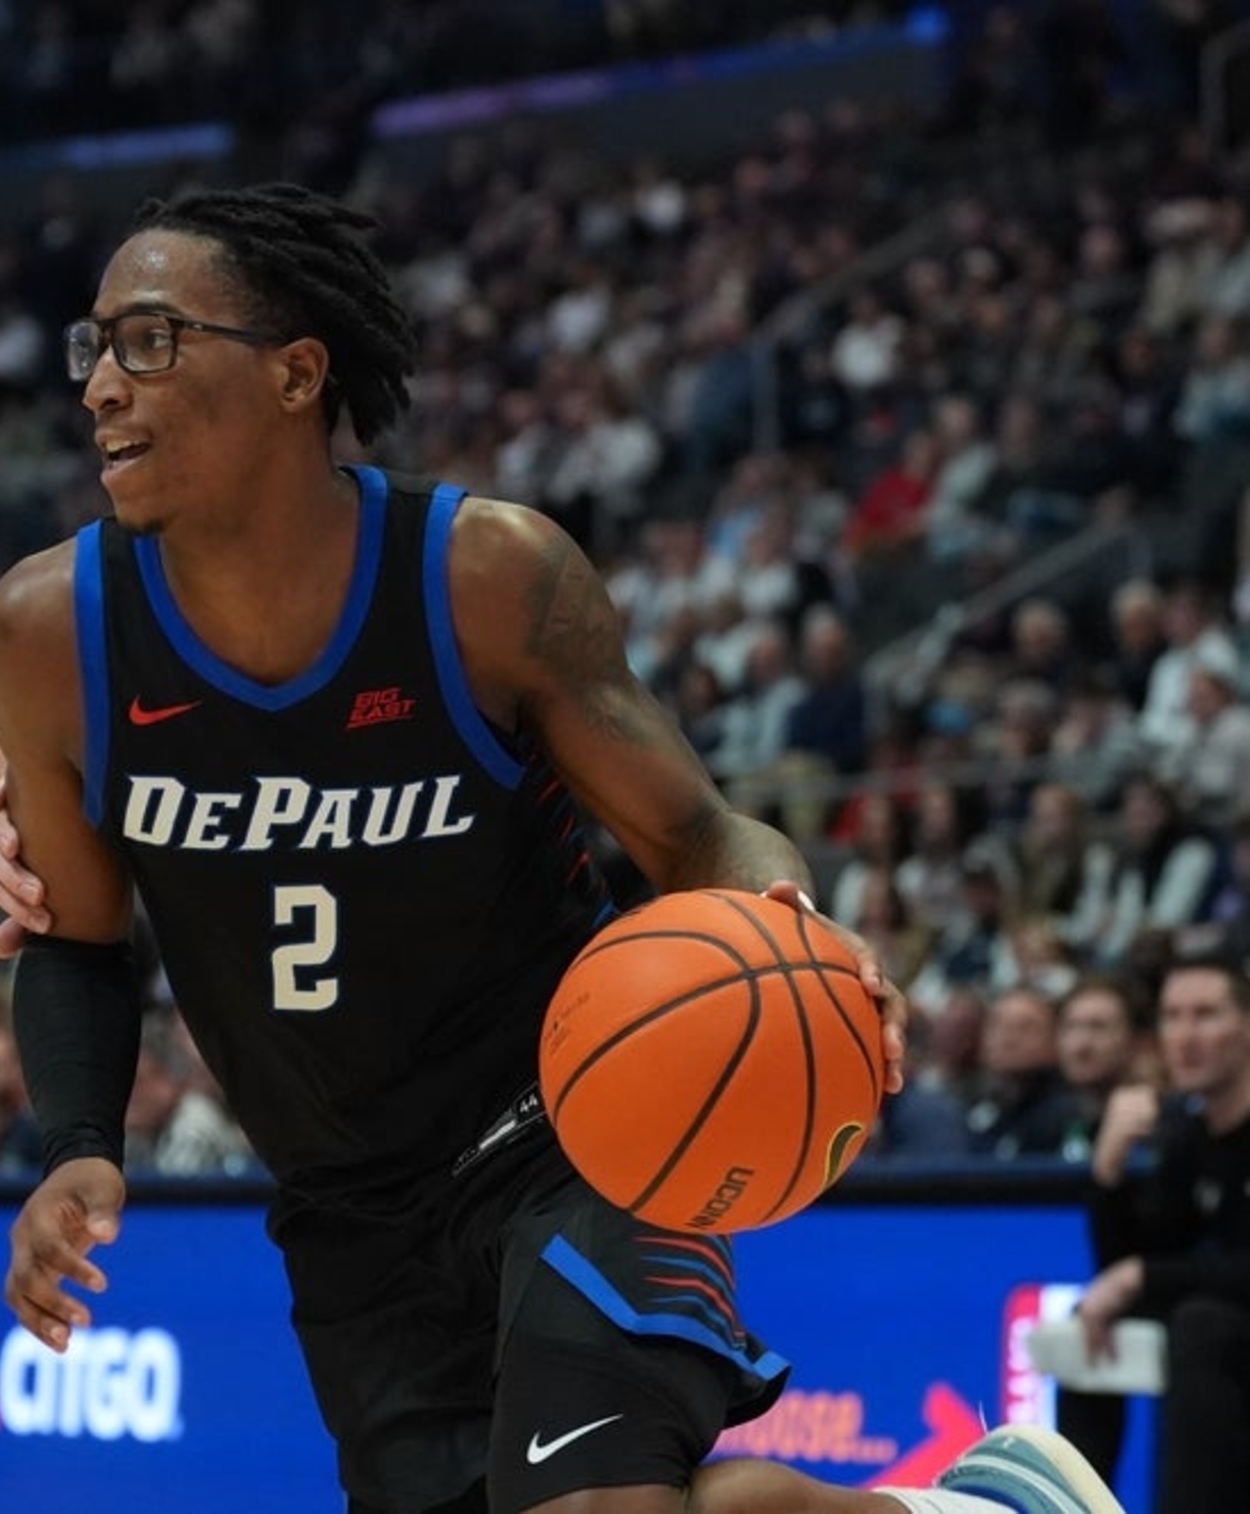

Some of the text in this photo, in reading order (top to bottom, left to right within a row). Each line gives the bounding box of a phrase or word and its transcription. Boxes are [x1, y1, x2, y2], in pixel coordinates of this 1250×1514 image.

[354, 687, 402, 705] BIG
[349, 699, 417, 722] EAST
[270, 884, 339, 1012] 2
